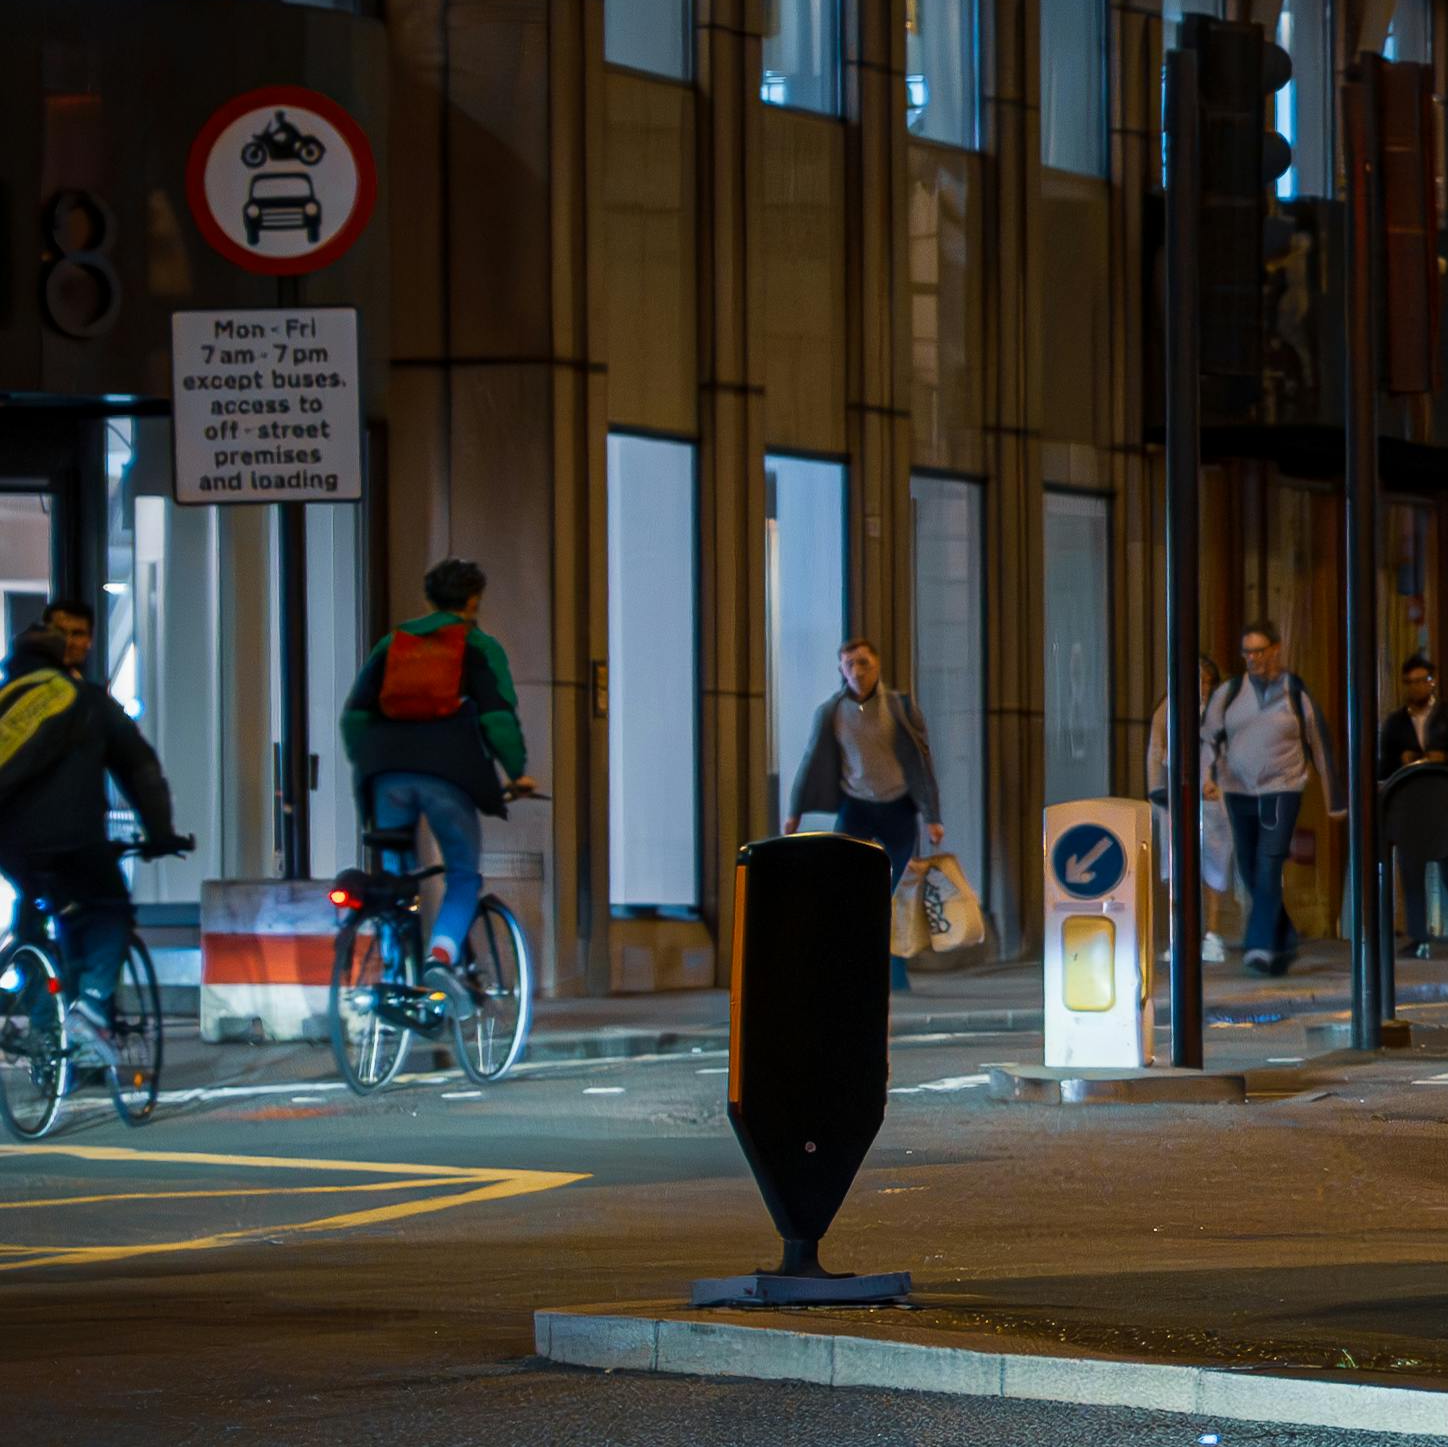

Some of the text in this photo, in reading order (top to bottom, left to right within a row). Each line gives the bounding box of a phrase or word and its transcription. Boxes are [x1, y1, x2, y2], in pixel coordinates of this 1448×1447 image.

[214, 319, 265, 339] Mon
[285, 317, 316, 339] Fri
[183, 370, 263, 391] except
[211, 395, 323, 415] access to
[214, 444, 322, 469] premises
[199, 469, 339, 492] and loading
